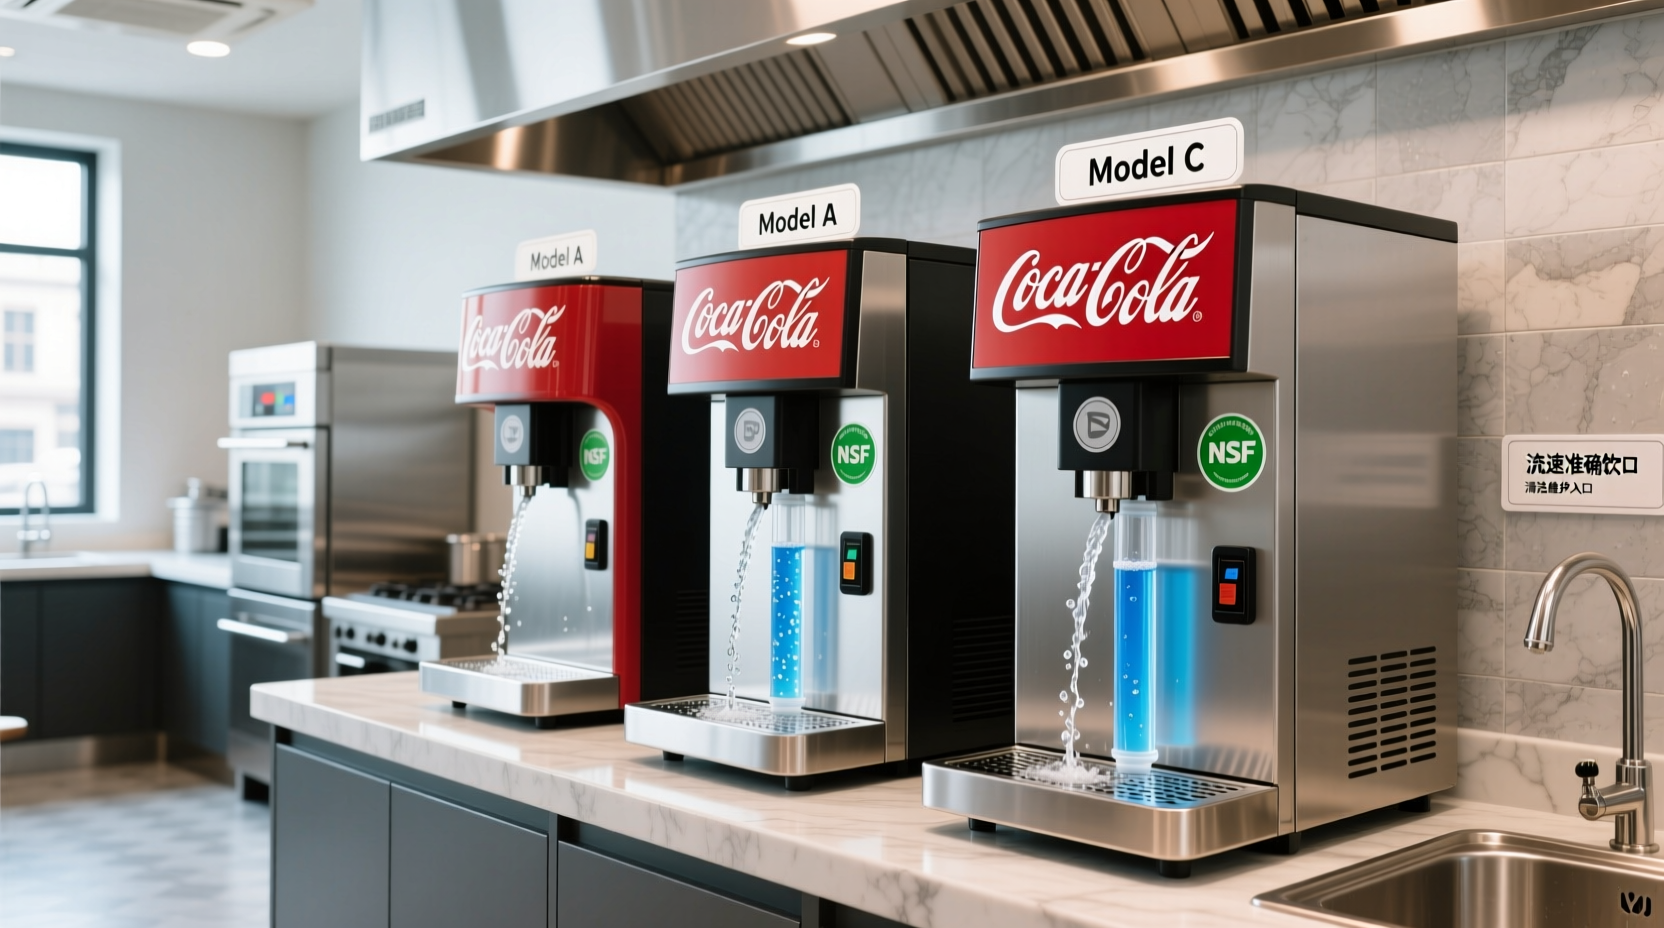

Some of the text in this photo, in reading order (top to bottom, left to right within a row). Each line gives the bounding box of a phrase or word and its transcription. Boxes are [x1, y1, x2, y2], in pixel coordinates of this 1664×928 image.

[1089, 142, 1205, 186] Model C
[758, 203, 837, 236] Model A
[529, 245, 584, 271] Model A
[992, 231, 1215, 333] Coca-Cola
[681, 276, 830, 355] Coca-Cola
[462, 304, 566, 371] Coca-Cola
[837, 444, 870, 465] NSF
[1208, 440, 1256, 464] NSF
